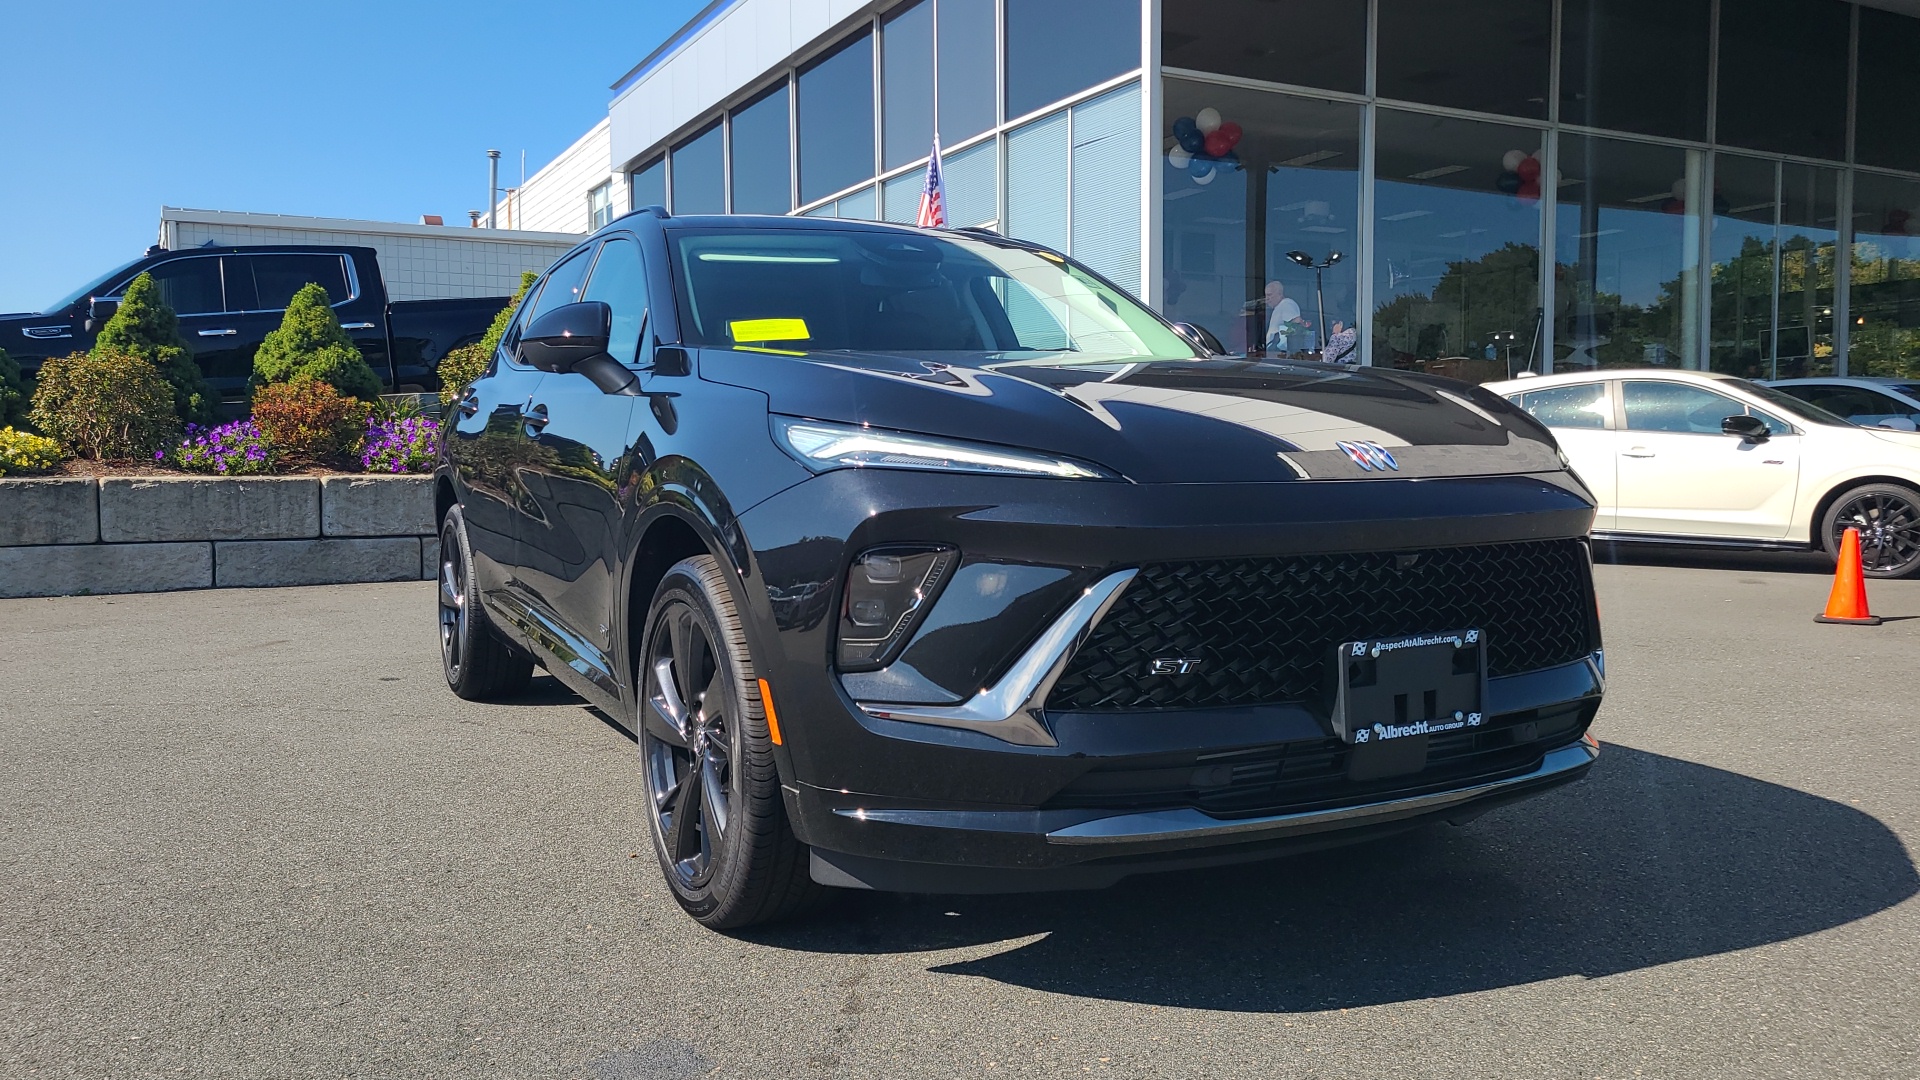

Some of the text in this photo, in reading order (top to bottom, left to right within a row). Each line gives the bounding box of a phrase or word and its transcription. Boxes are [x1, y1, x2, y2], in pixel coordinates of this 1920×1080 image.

[1375, 635, 1458, 651] RespectAtAlbrecht.com
[1151, 658, 1202, 675] ST
[1378, 721, 1464, 740] Albrecht AUTO GROUP
